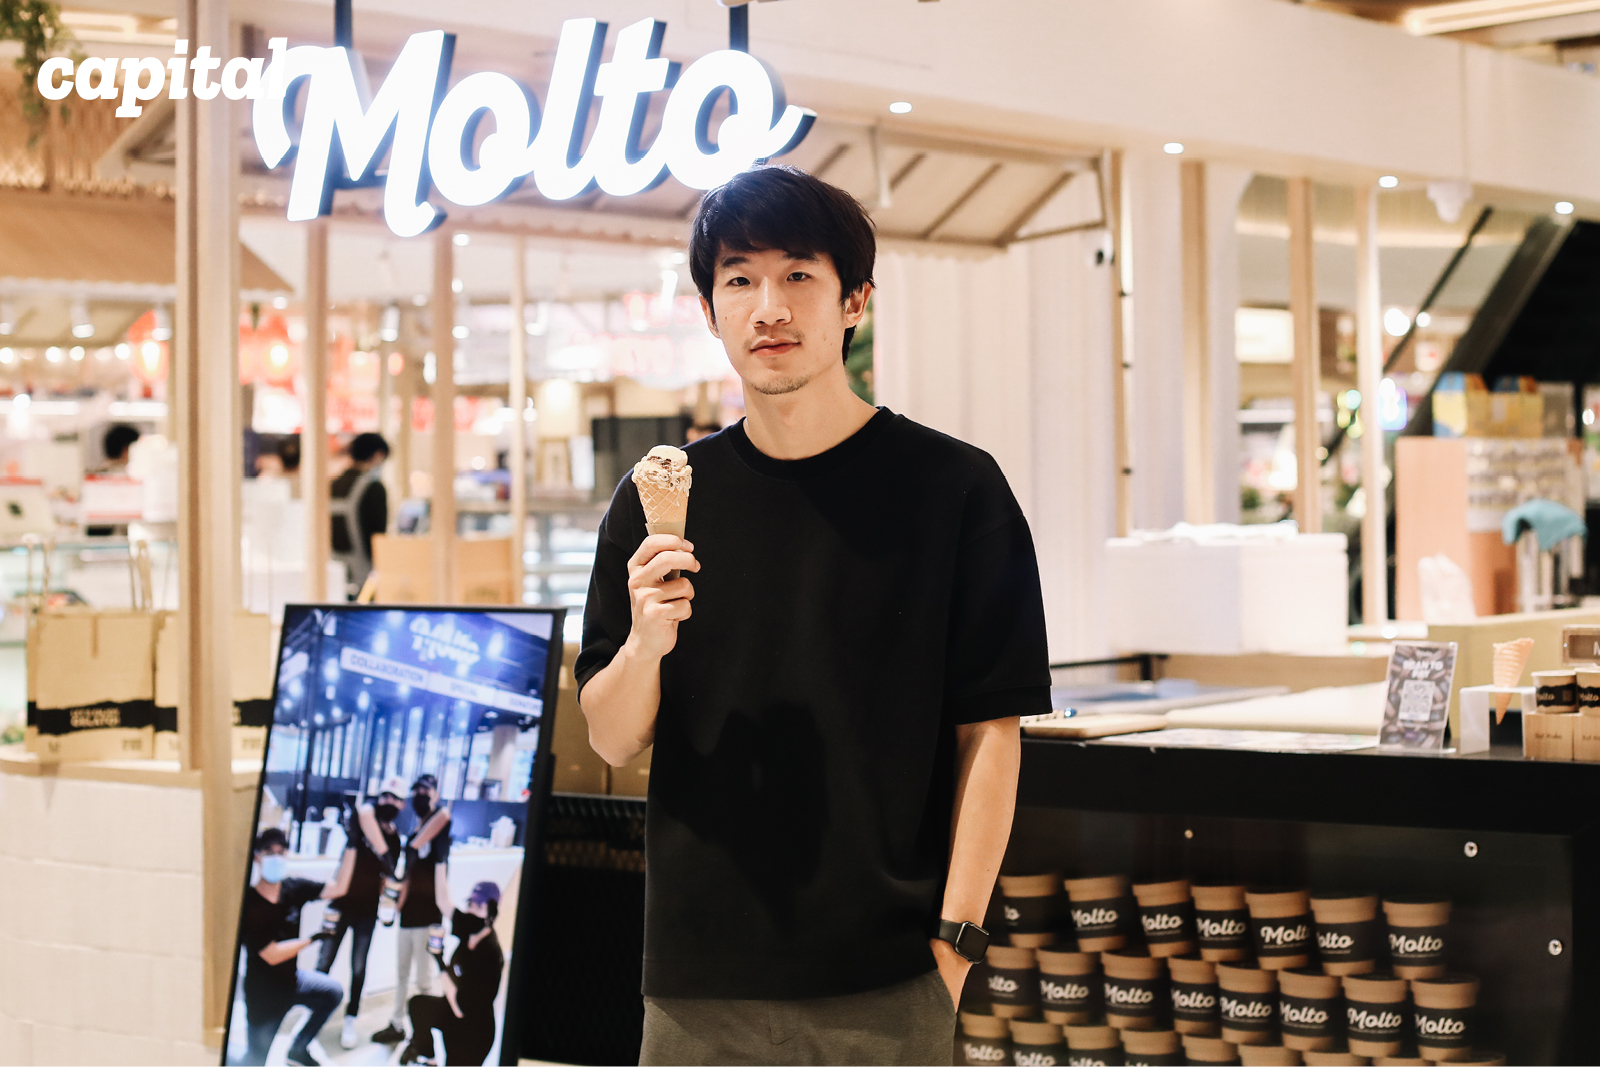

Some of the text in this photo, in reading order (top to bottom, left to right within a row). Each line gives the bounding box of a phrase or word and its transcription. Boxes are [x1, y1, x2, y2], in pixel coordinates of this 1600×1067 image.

[252, 17, 810, 237] Molto
[1260, 925, 1310, 945] Molt
[1388, 933, 1444, 954] Molto
[1219, 996, 1272, 1018] Molto
[1347, 1007, 1402, 1030] Molto
